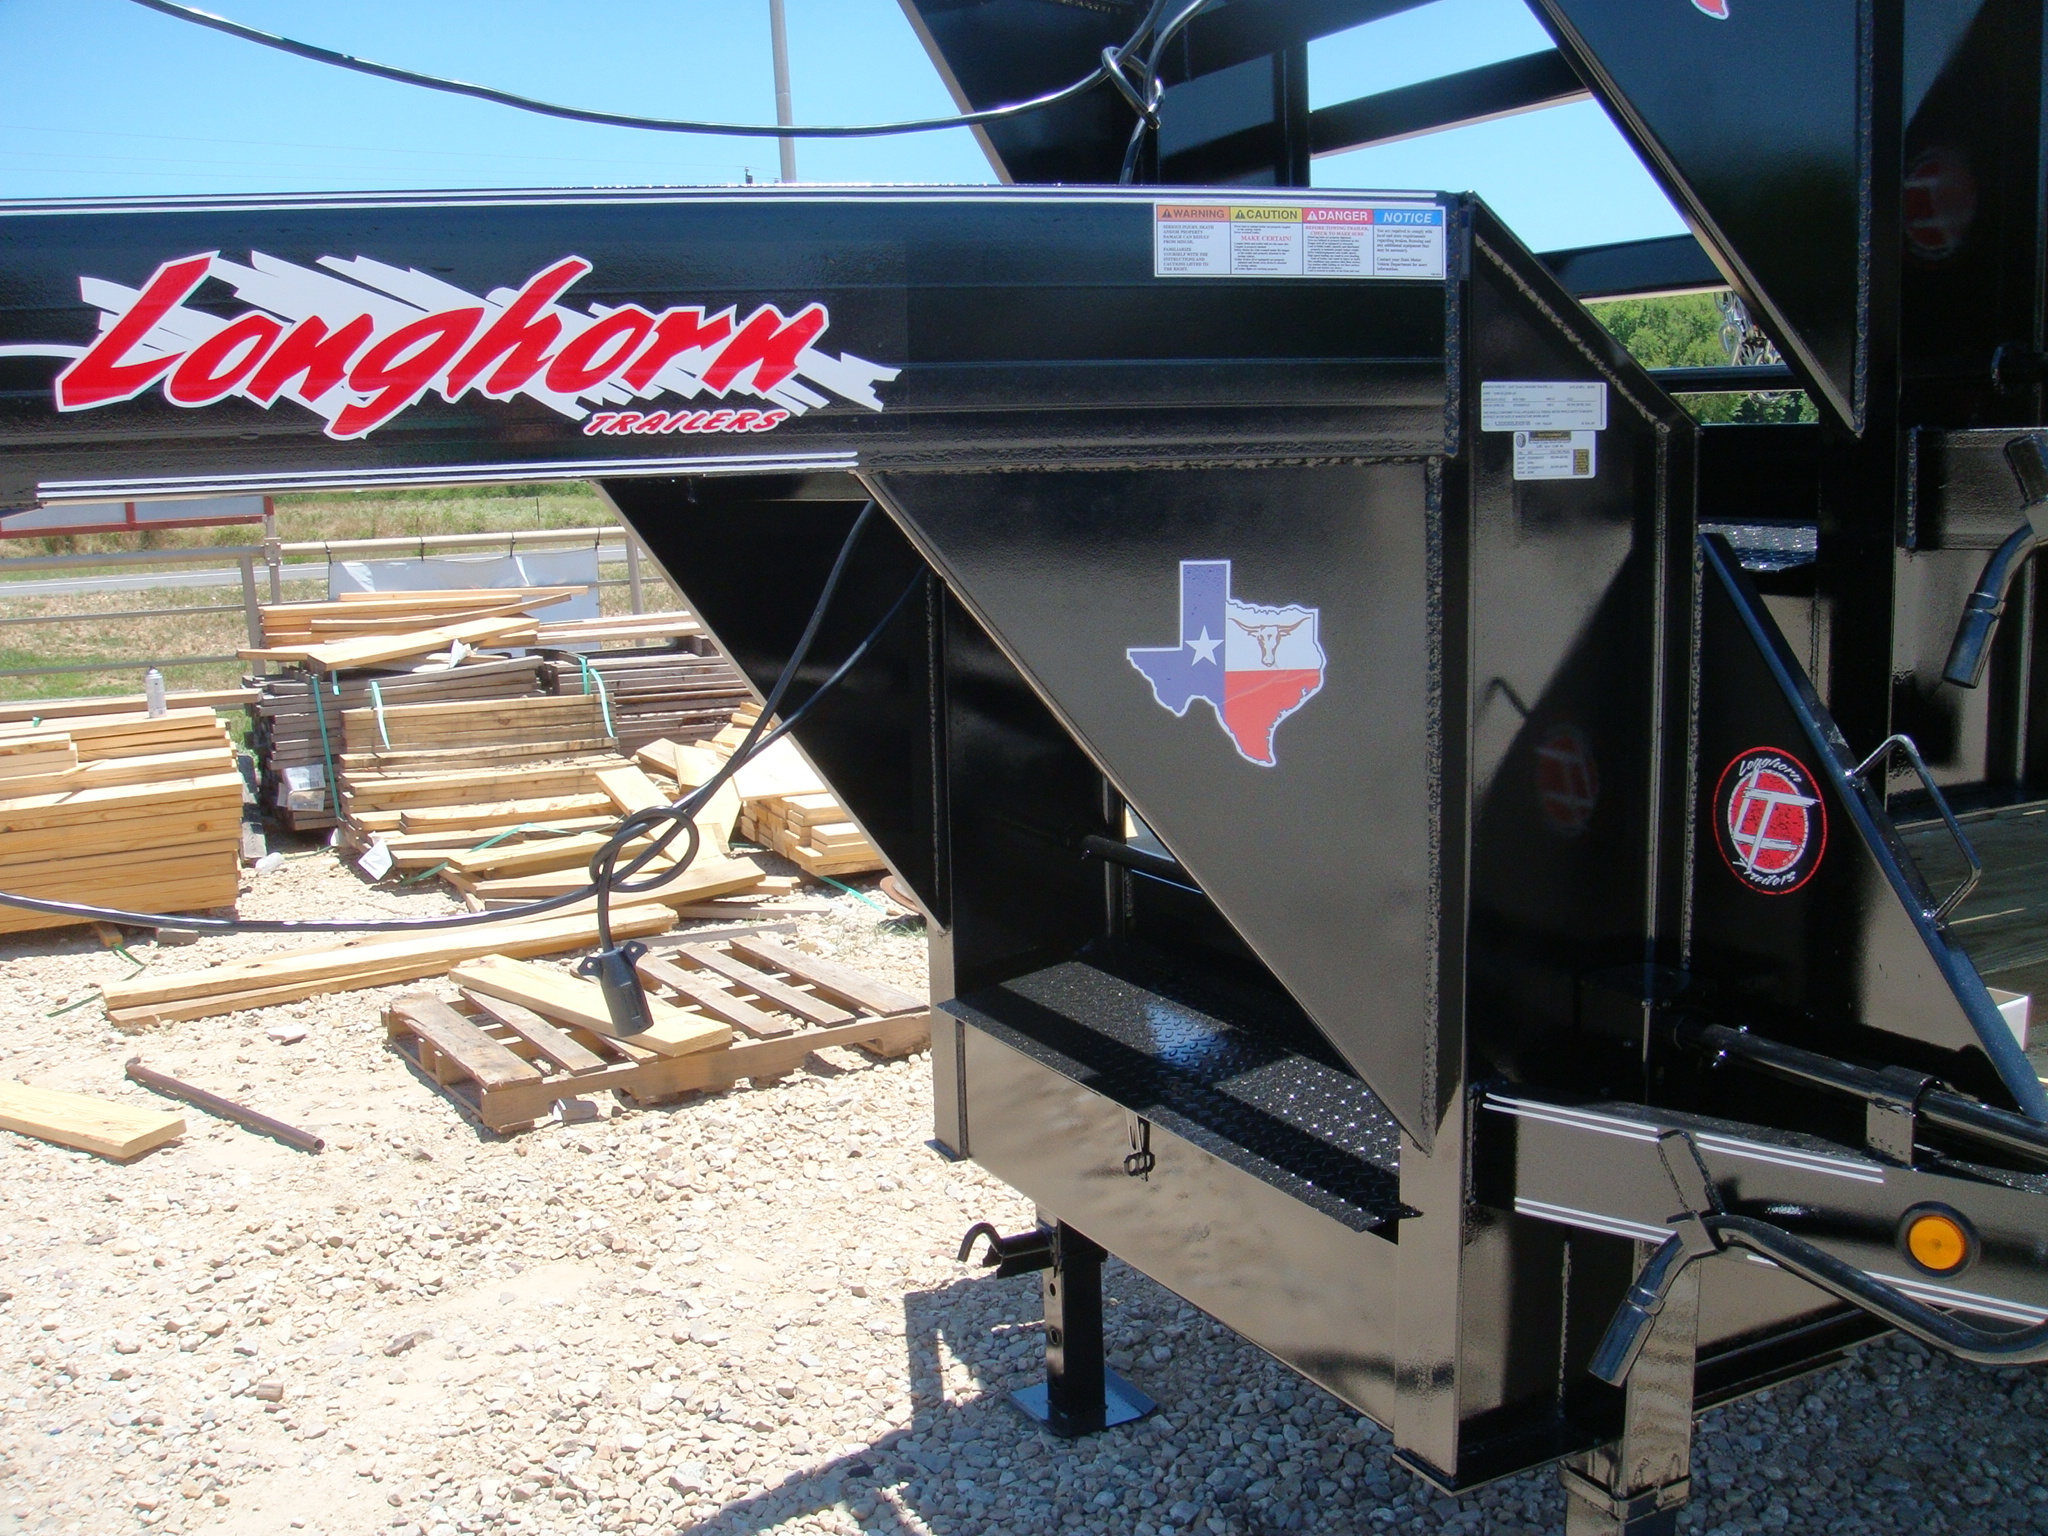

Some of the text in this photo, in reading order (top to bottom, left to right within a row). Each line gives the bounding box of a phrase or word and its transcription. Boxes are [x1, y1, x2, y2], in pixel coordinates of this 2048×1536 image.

[1174, 209, 1224, 219] WARNING
[1246, 210, 1297, 219] CAUTION
[1319, 211, 1368, 221] DANGER
[1384, 212, 1432, 223] NOTICE
[55, 250, 828, 441] Longhorn
[583, 408, 789, 438] TRAILERS
